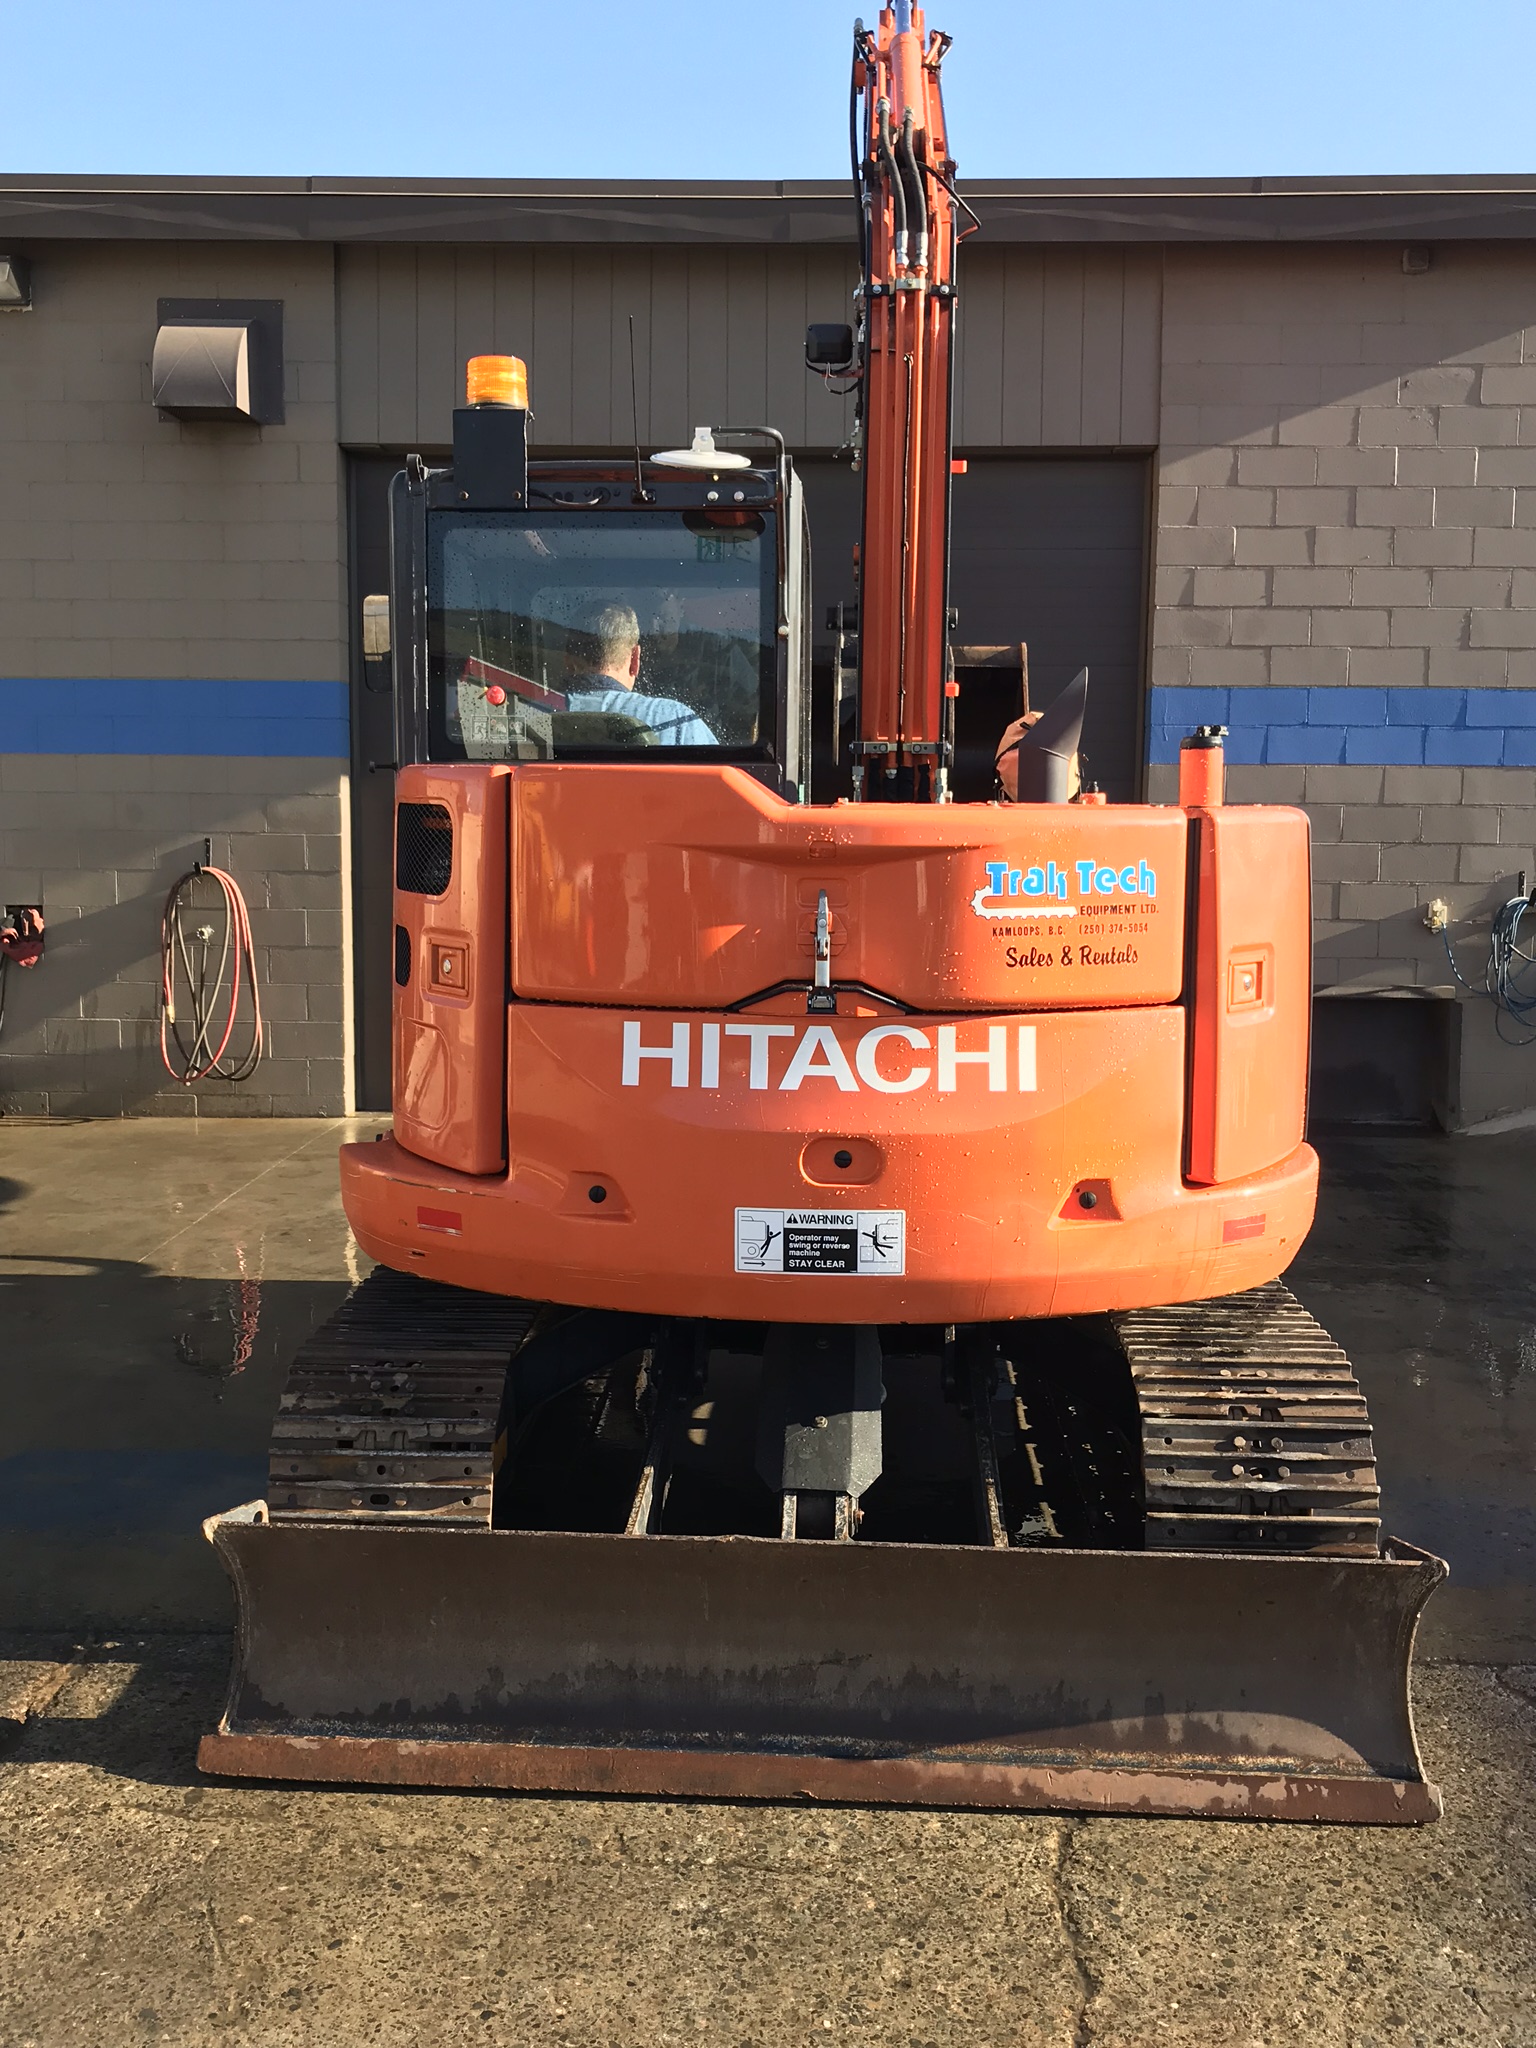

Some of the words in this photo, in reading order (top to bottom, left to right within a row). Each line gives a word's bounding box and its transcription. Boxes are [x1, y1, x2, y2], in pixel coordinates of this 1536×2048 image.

[986, 861, 1069, 900] Trak
[1076, 860, 1156, 898] Tech
[1080, 904, 1136, 916] EQUIPMENT
[1140, 903, 1159, 914] LTD.
[1048, 926, 1066, 935] B.C.
[1079, 924, 1105, 935] (250)
[1108, 923, 1148, 934] 374-5054
[1006, 947, 1053, 968] Sales
[1061, 945, 1073, 965] &
[1079, 944, 1138, 965] Rentals
[621, 1020, 1037, 1094] HITACHI
[799, 1214, 854, 1225] WARNING
[789, 1234, 822, 1242] Operator
[789, 1242, 811, 1250] swing
[789, 1259, 812, 1268] STAY
[814, 1260, 845, 1268] CLEAR
